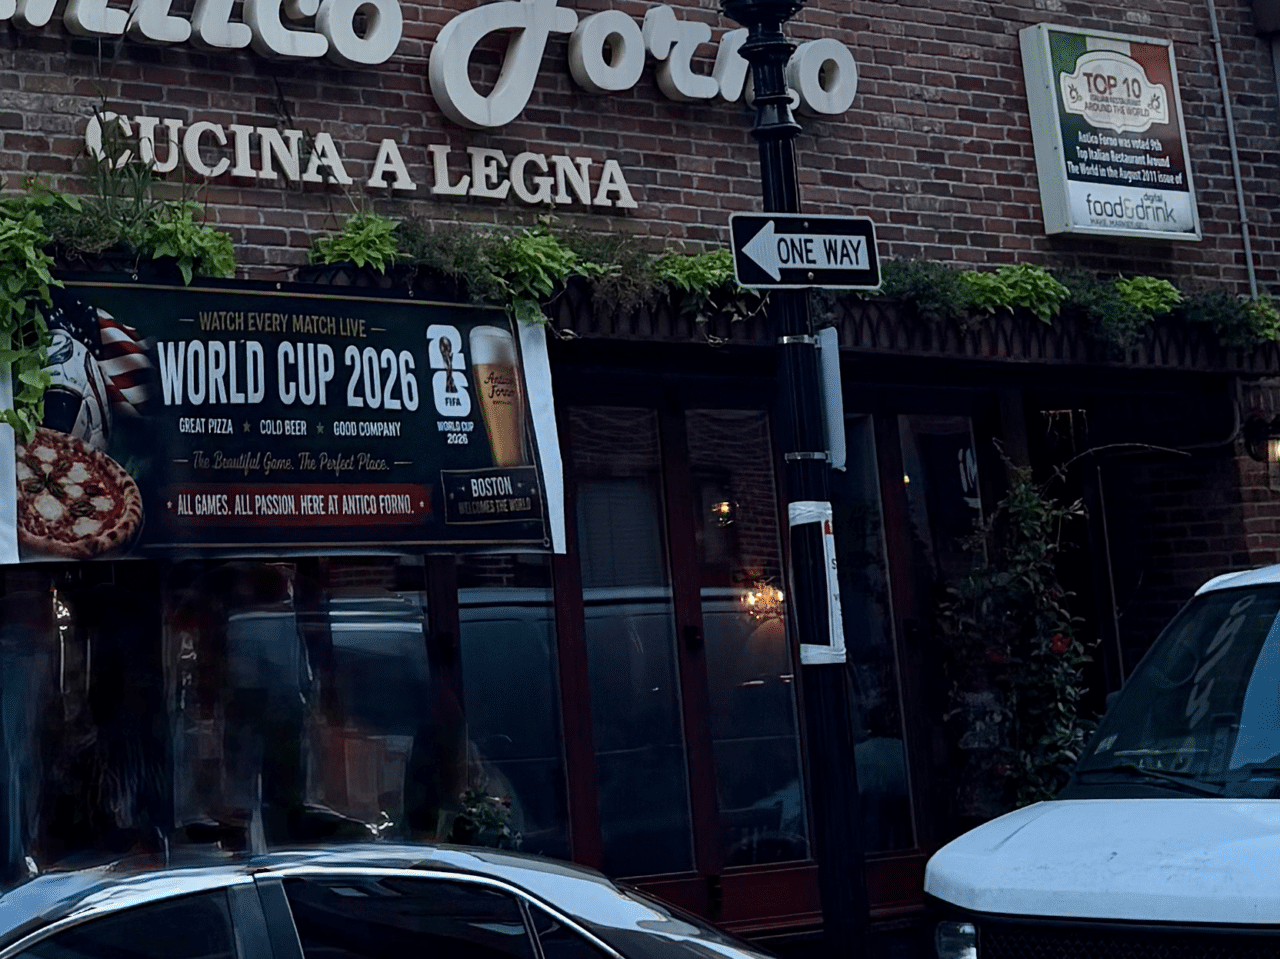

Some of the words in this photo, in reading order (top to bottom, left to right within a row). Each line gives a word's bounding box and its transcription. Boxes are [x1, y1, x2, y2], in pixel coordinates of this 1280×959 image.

[1083, 72, 1117, 95] TOP
[1123, 77, 1141, 98] 10
[1085, 102, 1112, 113] AROUND
[1125, 106, 1150, 117] WORLD
[86, 111, 354, 186] CUCINA
[367, 137, 414, 191] A
[428, 144, 638, 210] LEGNA
[1076, 146, 1088, 161] Top
[1067, 161, 1079, 174] The
[1080, 163, 1099, 176] World
[1142, 169, 1157, 182] 2011
[777, 237, 816, 264] ONE
[823, 239, 861, 265] WAY
[199, 311, 244, 331] WATCH
[247, 312, 289, 332] EVERY
[292, 314, 336, 335] MATCH
[339, 317, 367, 337] LIVE
[157, 340, 265, 406] WORLD
[277, 341, 335, 405] CUP
[344, 344, 419, 412] 2026
[445, 397, 461, 406] FIFA
[179, 417, 206, 434] GREAT
[209, 418, 234, 434] PIZZA
[259, 419, 283, 435] COLD
[285, 420, 307, 435] BEER
[333, 421, 357, 436] GOOD
[359, 421, 401, 437] COMPANY
[437, 421, 461, 431] WORLD
[461, 421, 474, 431] CUP
[447, 433, 468, 444] 2026
[193, 450, 210, 469] The
[212, 451, 260, 476] Beautiful
[263, 452, 294, 475] Game.
[298, 452, 317, 470] The
[319, 452, 355, 477] Perfect
[357, 453, 390, 470] Place.
[471, 476, 513, 497] BOSTON
[177, 494, 193, 516] ALL
[195, 494, 232, 516] GAMES.
[234, 494, 253, 515] ALL
[255, 494, 298, 515] PASSION.
[300, 494, 326, 515] HERE
[328, 494, 339, 515] AT
[342, 494, 377, 515] ANTICO
[379, 494, 414, 514] FORNO.
[495, 498, 508, 512] THE
[509, 497, 531, 511] WORLD
